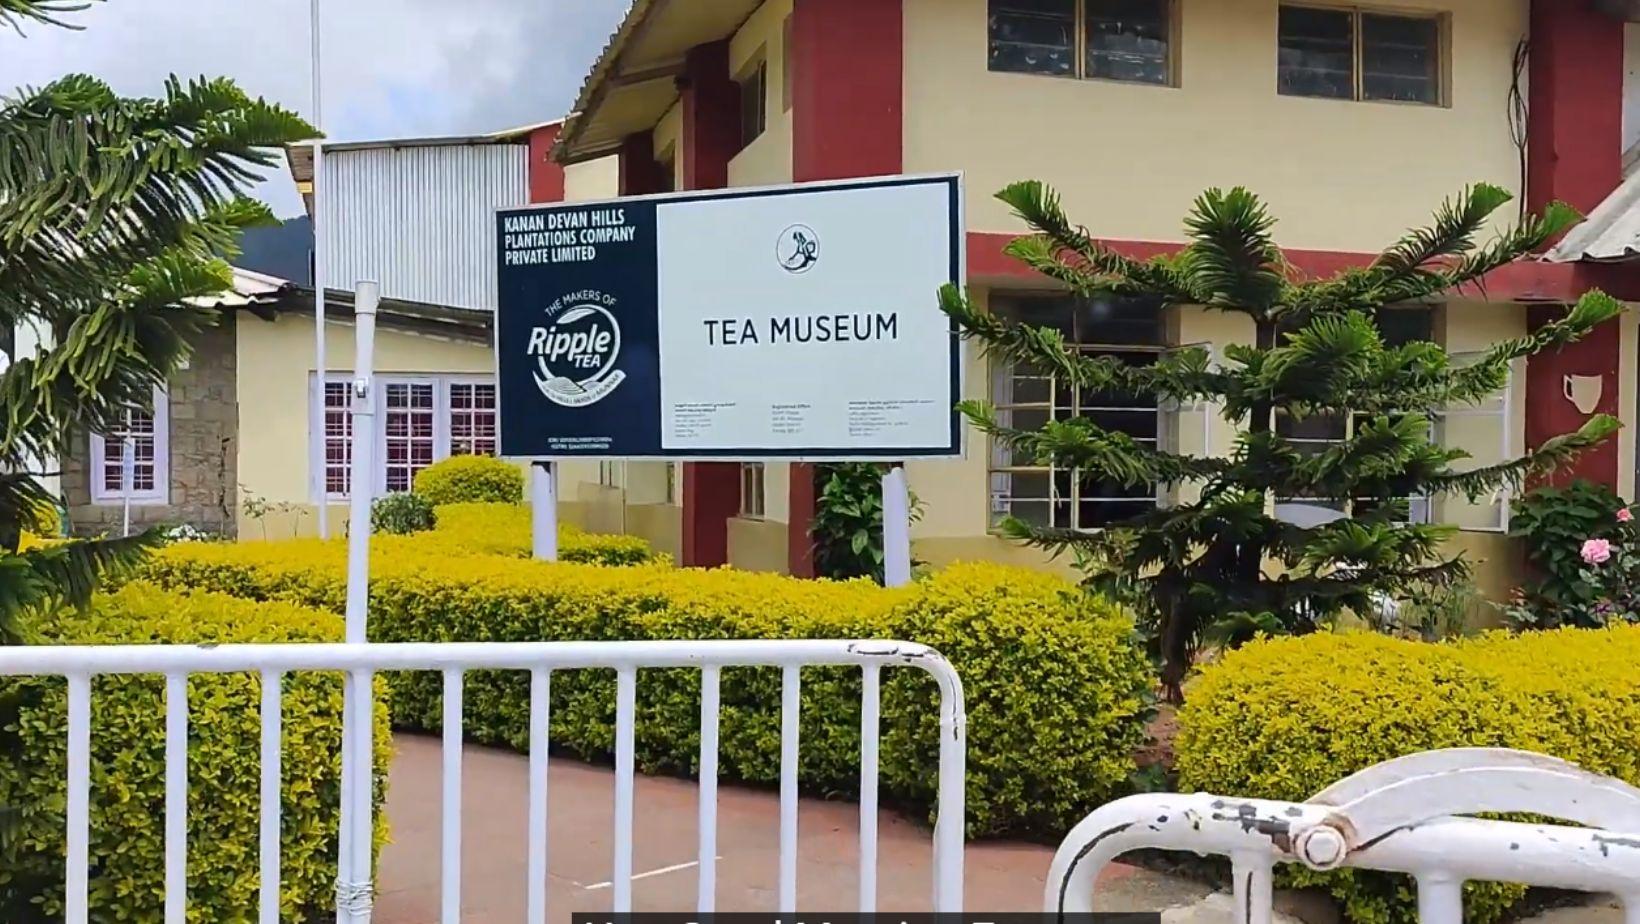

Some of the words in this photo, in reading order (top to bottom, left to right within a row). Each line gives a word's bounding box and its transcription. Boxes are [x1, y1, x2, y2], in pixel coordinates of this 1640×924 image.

[504, 216, 544, 232] KANAN
[548, 212, 587, 229] DEVAN
[591, 209, 625, 225] HILLS
[505, 230, 577, 249] PLANTATIONS
[580, 226, 635, 243] COMPANY
[505, 248, 548, 265] PRIVATE
[552, 246, 596, 262] LIMITED
[544, 299, 563, 317] THE
[562, 289, 601, 304] MAKERS
[602, 294, 616, 306] OF
[704, 319, 759, 345] TEA
[770, 312, 897, 343] MUSEUM
[527, 323, 611, 362] Ripple
[574, 354, 600, 368] TEA
